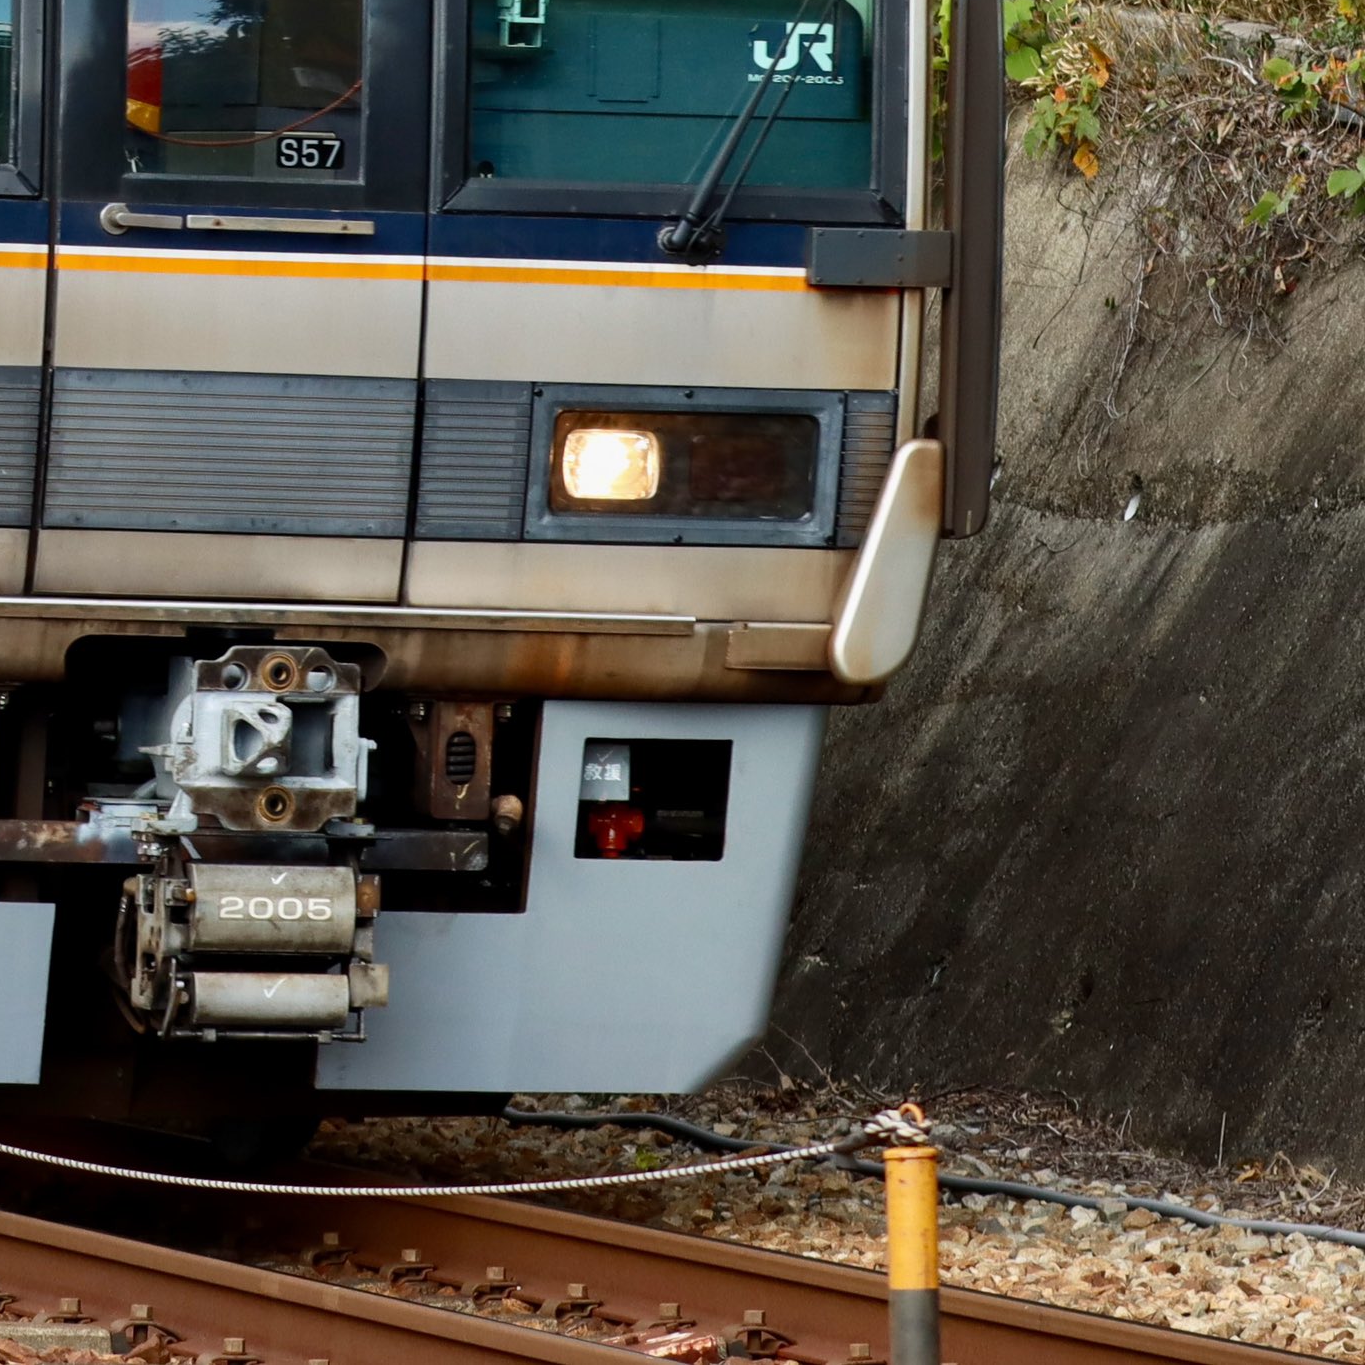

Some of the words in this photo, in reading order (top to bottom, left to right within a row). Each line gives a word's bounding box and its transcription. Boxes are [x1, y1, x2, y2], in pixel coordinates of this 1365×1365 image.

[753, 21, 834, 72] JR
[279, 138, 342, 168] S57
[219, 896, 333, 921] 2005
